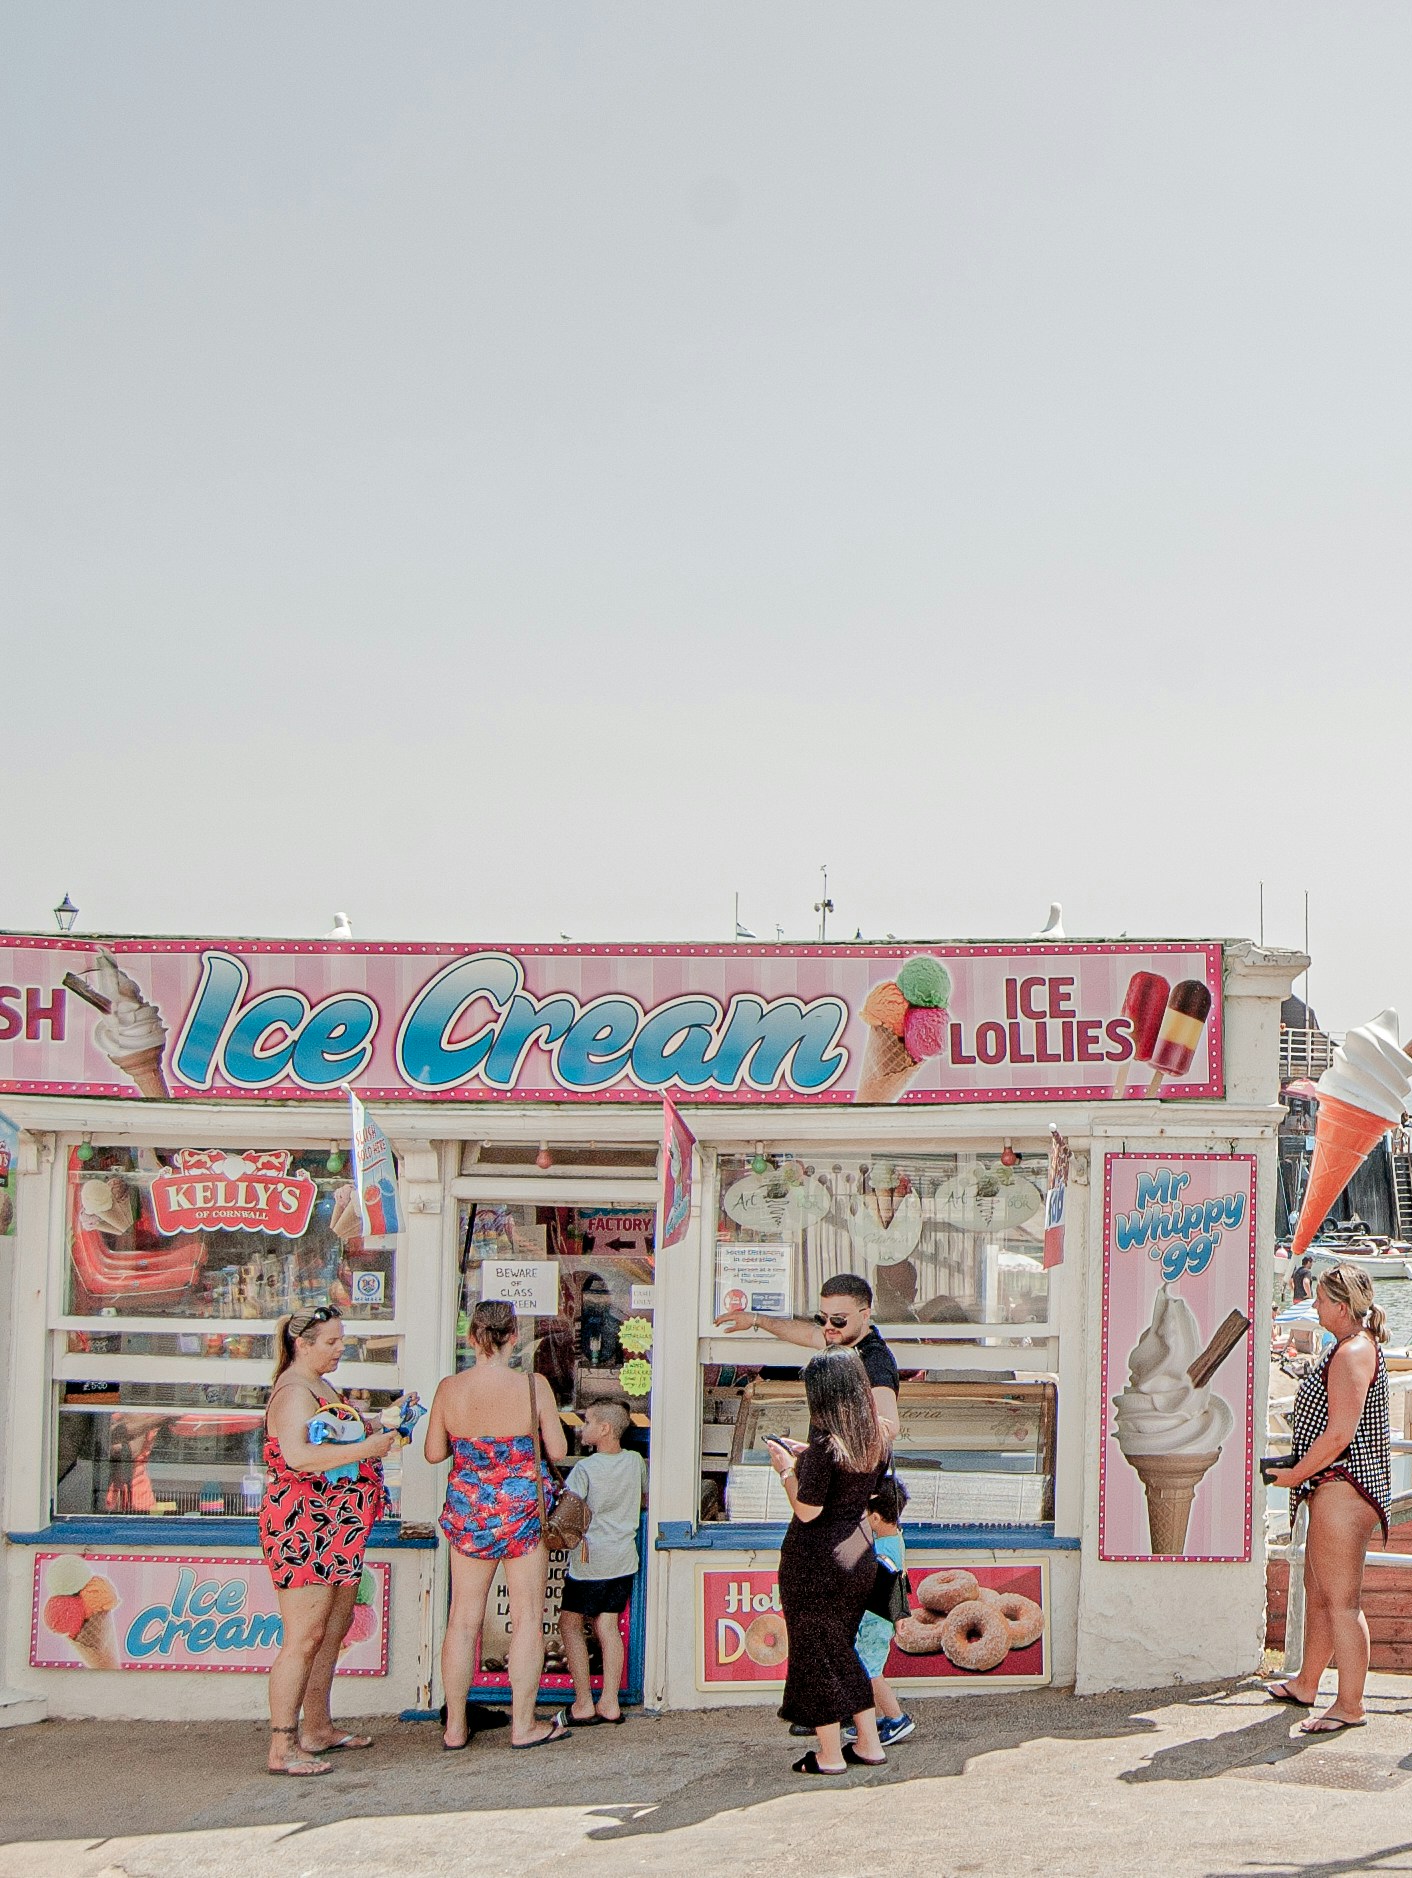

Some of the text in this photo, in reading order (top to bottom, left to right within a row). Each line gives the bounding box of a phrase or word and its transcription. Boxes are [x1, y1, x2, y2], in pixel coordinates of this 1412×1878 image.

[1005, 976, 1076, 1020] ICE
[174, 952, 848, 1092] Ice Cream
[950, 1018, 1134, 1065] LOLLIES
[166, 1181, 300, 1214] KELLY'S
[1136, 1168, 1190, 1212] Mr
[195, 1210, 269, 1220] OF CORNWALL
[588, 1217, 651, 1232] FACTORY
[1116, 1192, 1246, 1252] Whippy
[496, 1268, 538, 1278] BEWARE
[513, 1300, 537, 1309] REEN
[170, 1566, 248, 1619] Ice
[724, 1582, 783, 1613] Hot
[126, 1604, 285, 1659] Cream
